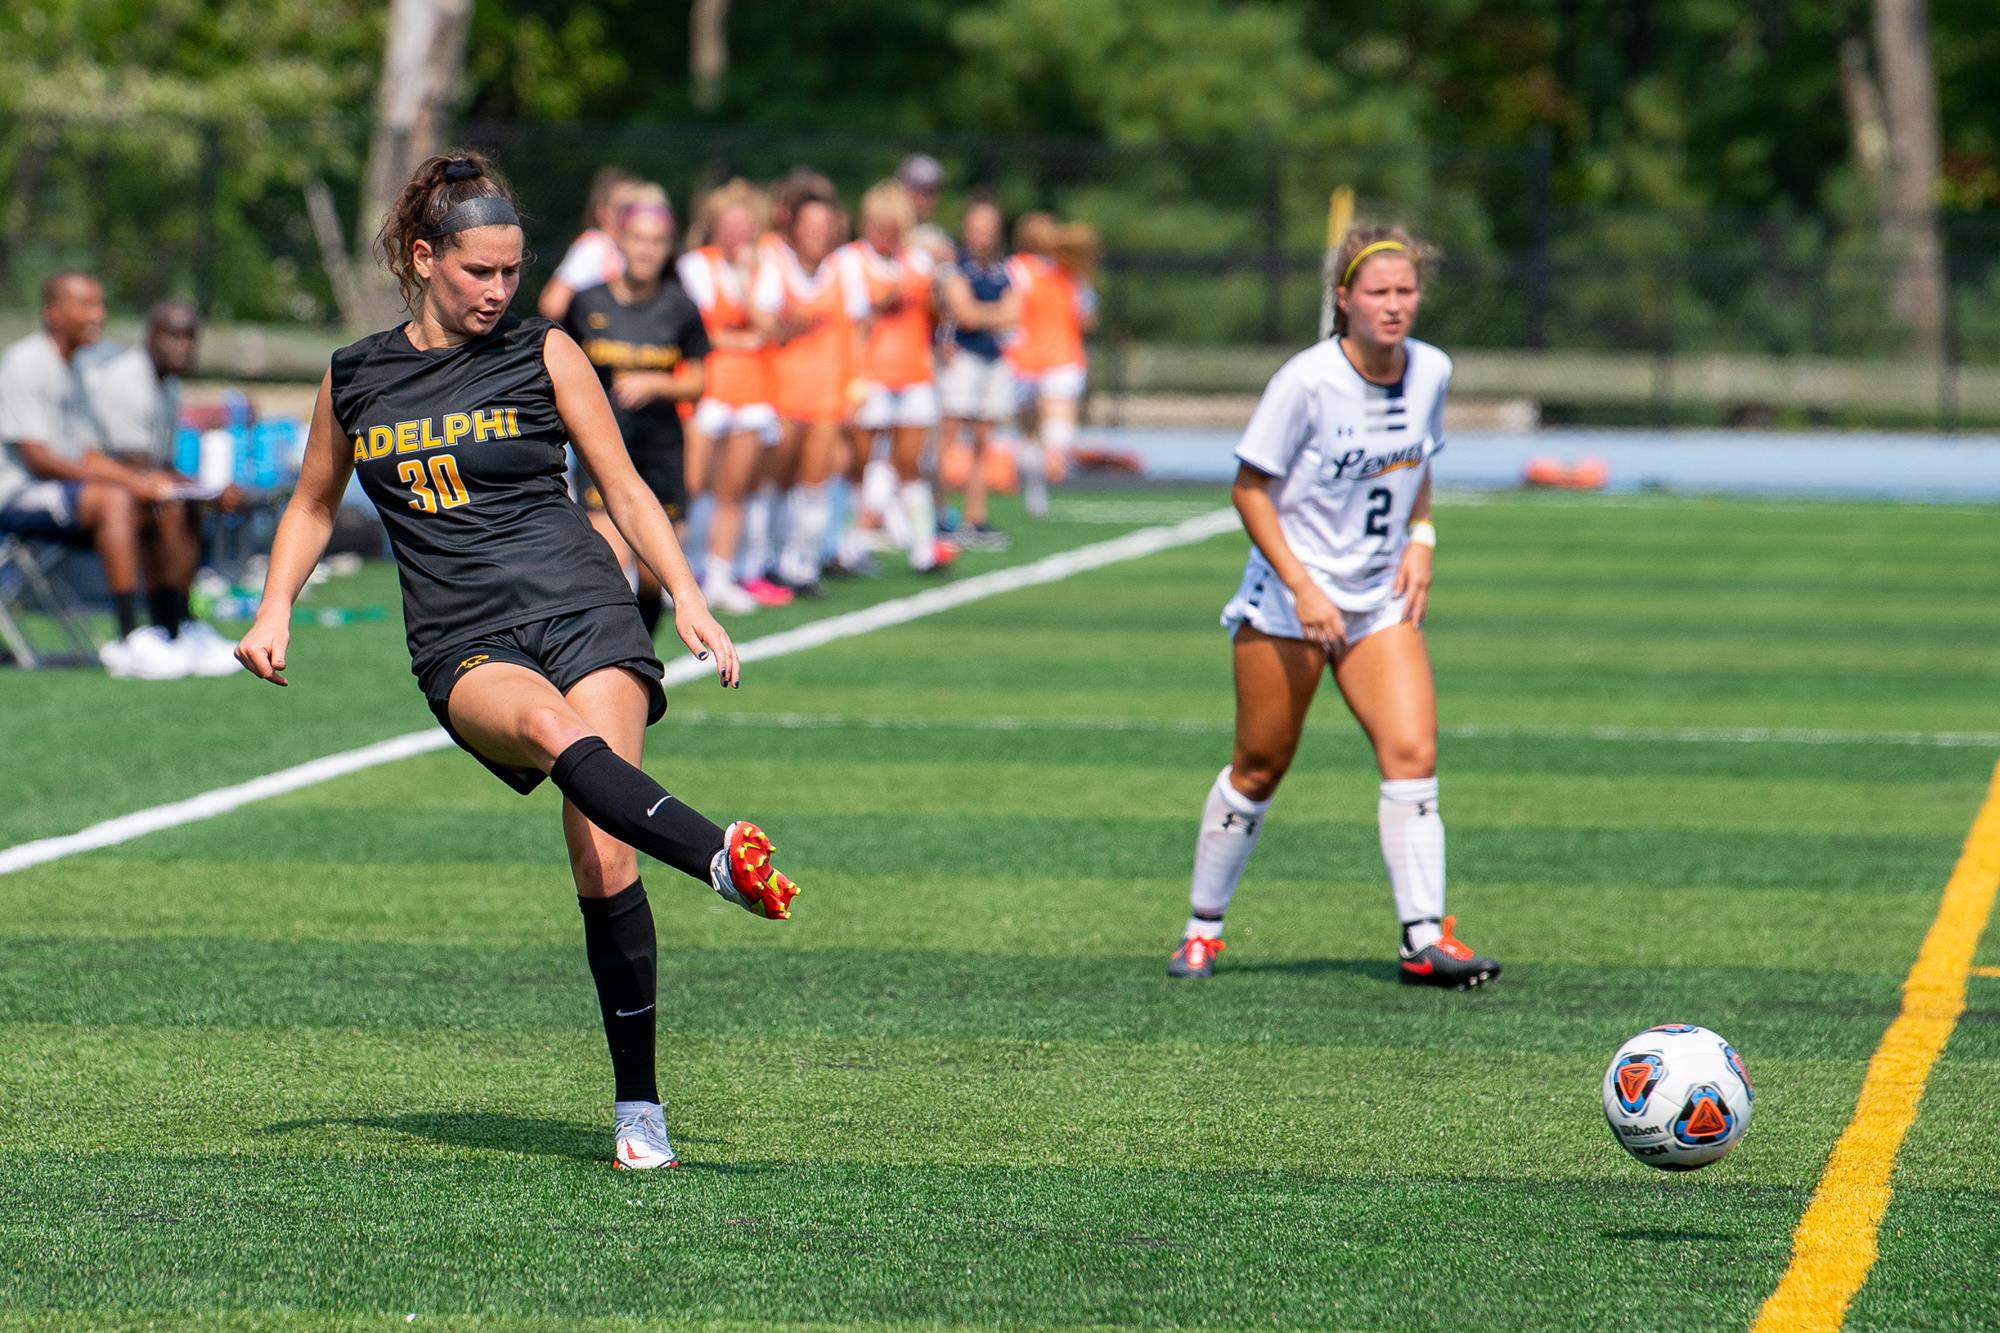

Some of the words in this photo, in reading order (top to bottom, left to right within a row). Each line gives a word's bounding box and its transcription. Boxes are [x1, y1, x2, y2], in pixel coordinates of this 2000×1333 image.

[354, 408, 521, 463] ADELPHI
[397, 454, 471, 514] 30
[1366, 487, 1392, 536] 2
